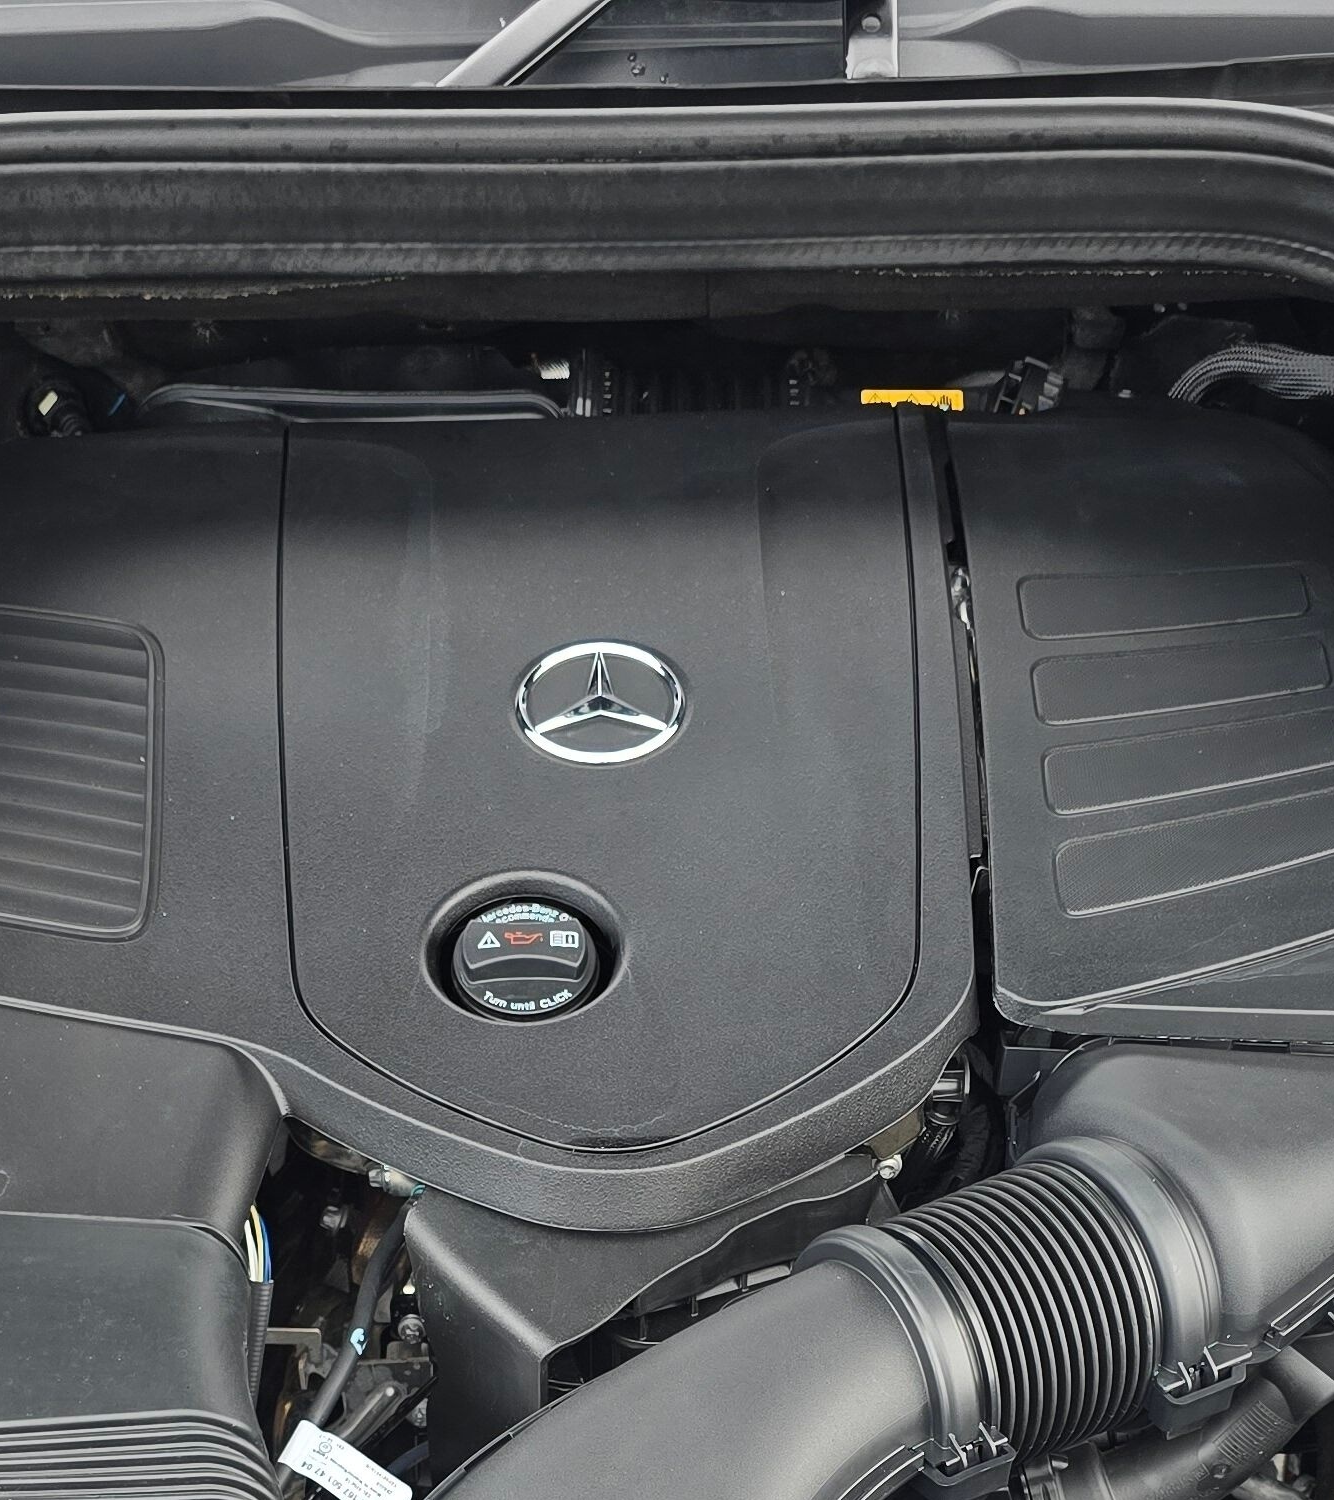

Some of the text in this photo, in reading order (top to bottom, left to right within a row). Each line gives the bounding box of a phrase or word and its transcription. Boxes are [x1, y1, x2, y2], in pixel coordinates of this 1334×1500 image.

[483, 988, 573, 1011] Turn until CLICK
[314, 1467, 326, 1477] 47
[327, 1476, 343, 1490] 501
